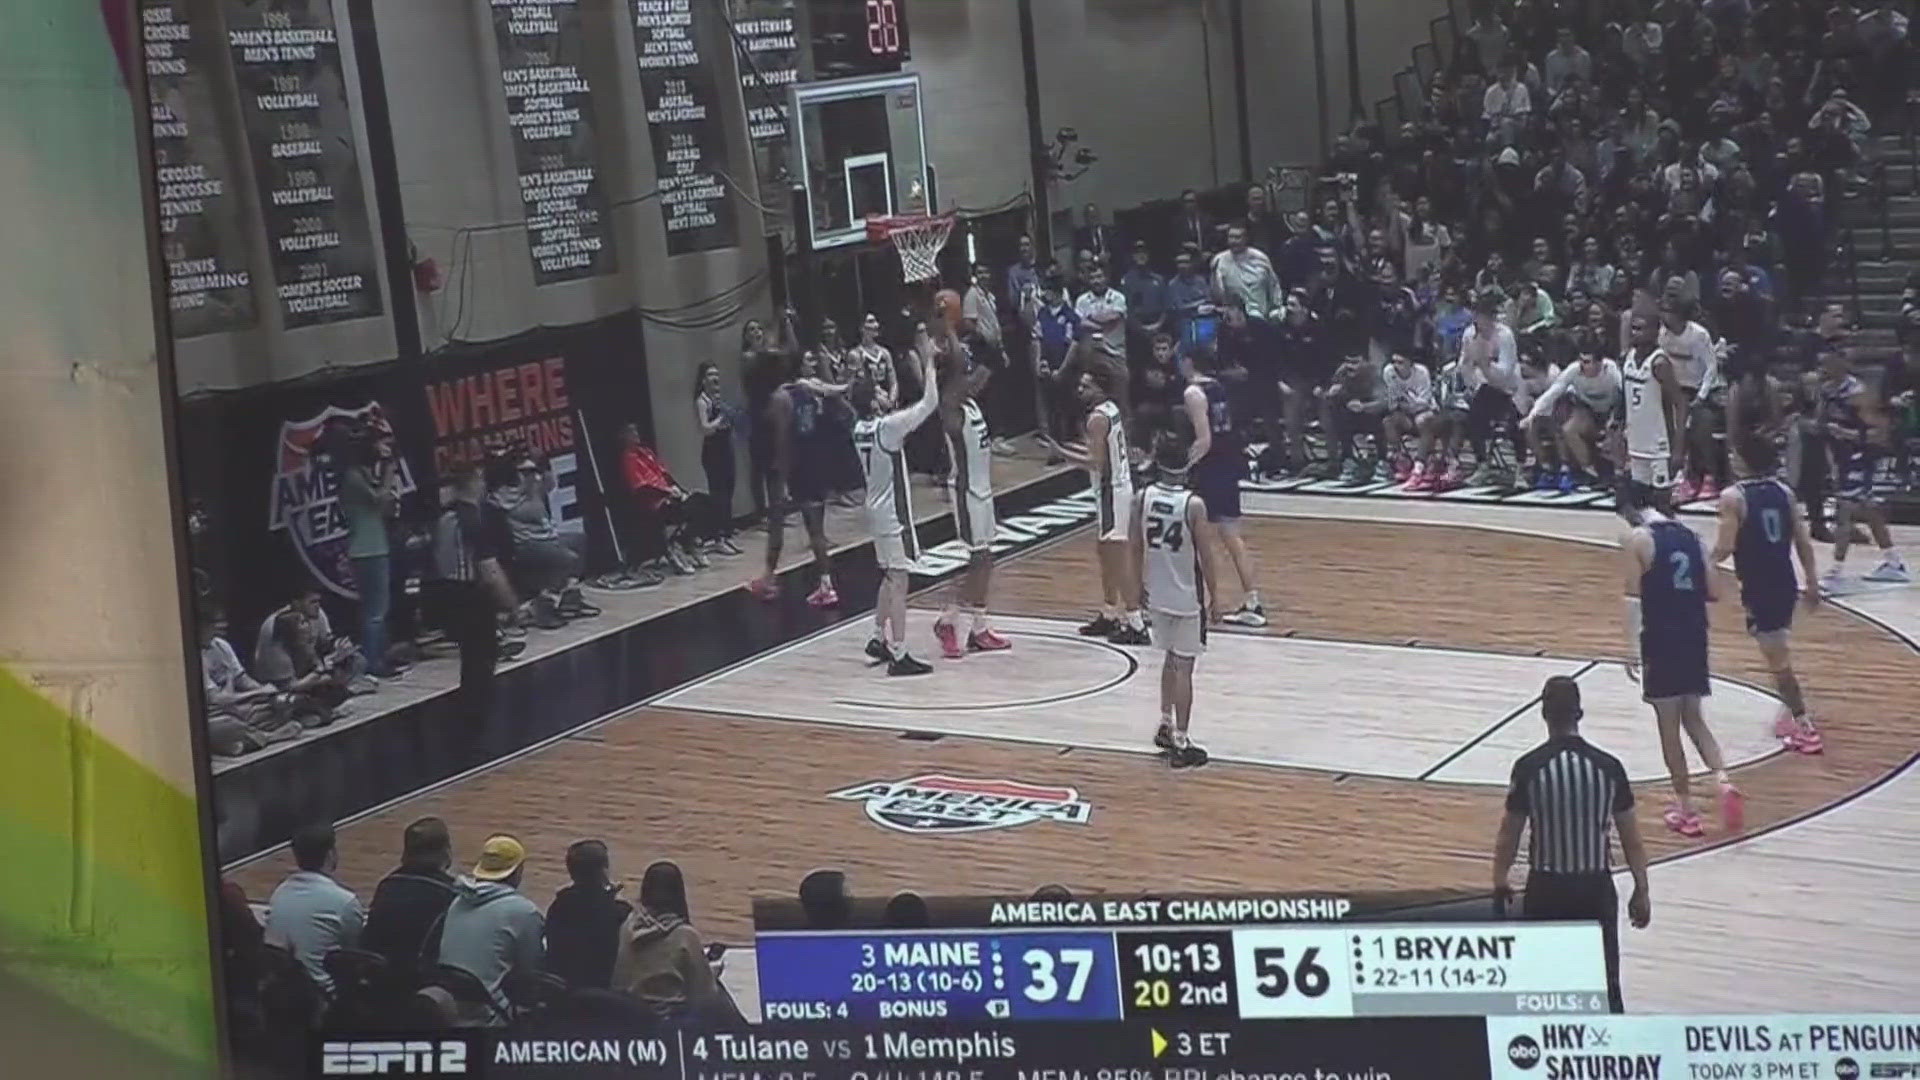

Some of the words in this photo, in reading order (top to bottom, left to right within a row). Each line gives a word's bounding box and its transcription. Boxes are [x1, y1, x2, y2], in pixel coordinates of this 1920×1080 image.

[508, 20, 559, 34] VOLLEYBALL
[257, 93, 319, 110] VOLLEYBALL
[271, 141, 322, 158] BASEBALL
[272, 186, 334, 205] VOLLEYBALL
[280, 232, 340, 251] VOLLEYBALL
[171, 272, 249, 293] SWIMMING
[287, 292, 350, 313] VOLLEYBALL
[425, 357, 569, 437] WHERE
[1632, 387, 1642, 406] 5
[1147, 516, 1185, 553] 24
[1762, 508, 1784, 544] 0
[1671, 551, 1694, 591] 2
[830, 779, 1092, 826] AMERICA
[991, 903, 1096, 923] AMERICA
[1104, 902, 1159, 921] EAST
[1167, 899, 1351, 921] CHAMPIONSHIP
[861, 944, 876, 966] 3
[884, 942, 980, 967] MAINE
[1134, 944, 1222, 973] 10:13
[1373, 939, 1384, 960] 1
[1395, 936, 1516, 960] BRYANT
[851, 973, 911, 993] 20-13
[916, 971, 983, 993] (10-6)
[1023, 949, 1094, 1002] 37
[1253, 948, 1330, 998] 56
[1373, 967, 1434, 987] 22-11
[1440, 966, 1507, 988] (14-2)
[1134, 982, 1170, 1007] 20
[1178, 981, 1228, 1005] 2nd
[1516, 994, 1583, 1011] FOULS:
[1589, 995, 1602, 1011] 6
[766, 1002, 831, 1019] FOULS:
[836, 1001, 849, 1018] 4
[879, 1001, 948, 1018] BONUS
[693, 1037, 708, 1060] 4
[715, 1034, 809, 1061] Tulane
[864, 1035, 878, 1060] 1
[884, 1032, 1015, 1066] Memphis
[1177, 1033, 1192, 1056] 3
[1200, 1032, 1231, 1056] ET
[1542, 1024, 1585, 1050] HKY
[1685, 1026, 1772, 1052] DEVILS
[1778, 1033, 1803, 1052] AT
[494, 1040, 620, 1064] AMERICAN
[628, 1040, 667, 1067] (M)
[1546, 1054, 1661, 1080] SATURDAY
[1689, 1063, 1746, 1080] TODAY
[1752, 1063, 1763, 1080] 3
[1767, 1063, 1794, 1080] PM
[1799, 1063, 1820, 1080] ET
